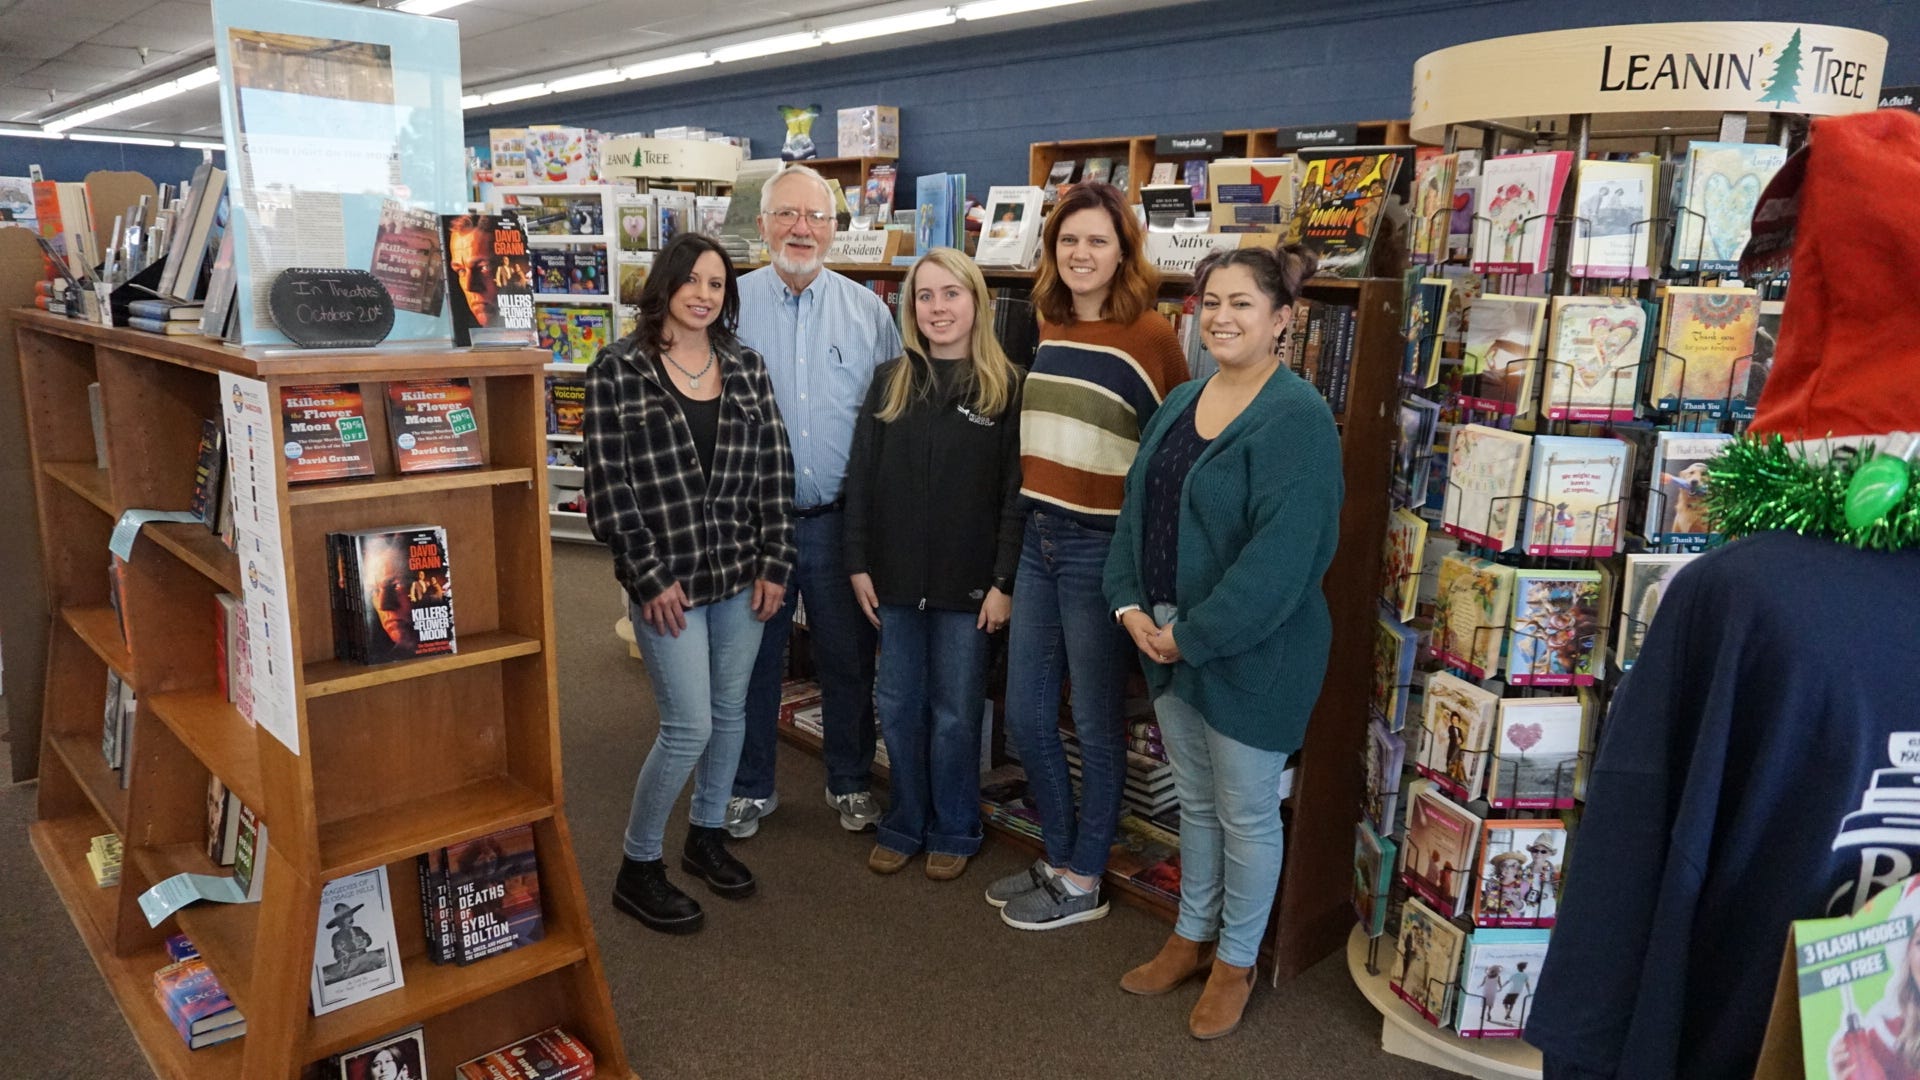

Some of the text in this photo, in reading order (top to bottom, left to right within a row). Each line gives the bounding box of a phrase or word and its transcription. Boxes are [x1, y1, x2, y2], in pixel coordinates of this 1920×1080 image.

[1600, 45, 1867, 99] LEANIN' TREE
[1879, 95, 1913, 106] Adult
[644, 151, 671, 165] TREE
[494, 229, 521, 242] DAVID
[1169, 235, 1214, 248] Native
[381, 243, 417, 256] Killers
[494, 242, 524, 255] GRANN
[842, 243, 883, 256] Residents
[376, 262, 407, 275] Moon
[290, 281, 322, 296] In
[497, 294, 532, 307] KILLERS
[296, 304, 355, 324] October
[504, 306, 533, 318] FLOWER
[505, 317, 531, 329] MOON
[401, 391, 446, 400] Killers
[554, 390, 585, 399] Volcano
[286, 397, 335, 408] Killers
[417, 402, 462, 412] Flower
[304, 410, 352, 419] Flower
[405, 415, 442, 425] Moon
[451, 411, 470, 423] 20%
[291, 422, 332, 432] Moon
[341, 420, 362, 430] 20%
[455, 423, 473, 432] OFF
[344, 432, 364, 440] OFF
[411, 445, 469, 456] David Grann
[298, 455, 361, 465] David Grann
[409, 543, 437, 558] DAVID
[409, 556, 441, 570] GRANN
[412, 606, 448, 622] KILLERS
[419, 618, 449, 632] FLOWER
[419, 628, 448, 642] MOON
[457, 882, 475, 896] THE
[458, 884, 505, 910] DEATHS
[460, 908, 471, 920] OF
[462, 912, 497, 934] SYBIL
[463, 921, 510, 948] BOLTON
[1804, 918, 1908, 964] 3 FLASH MODES!
[1821, 953, 1884, 988] BPA FREE
